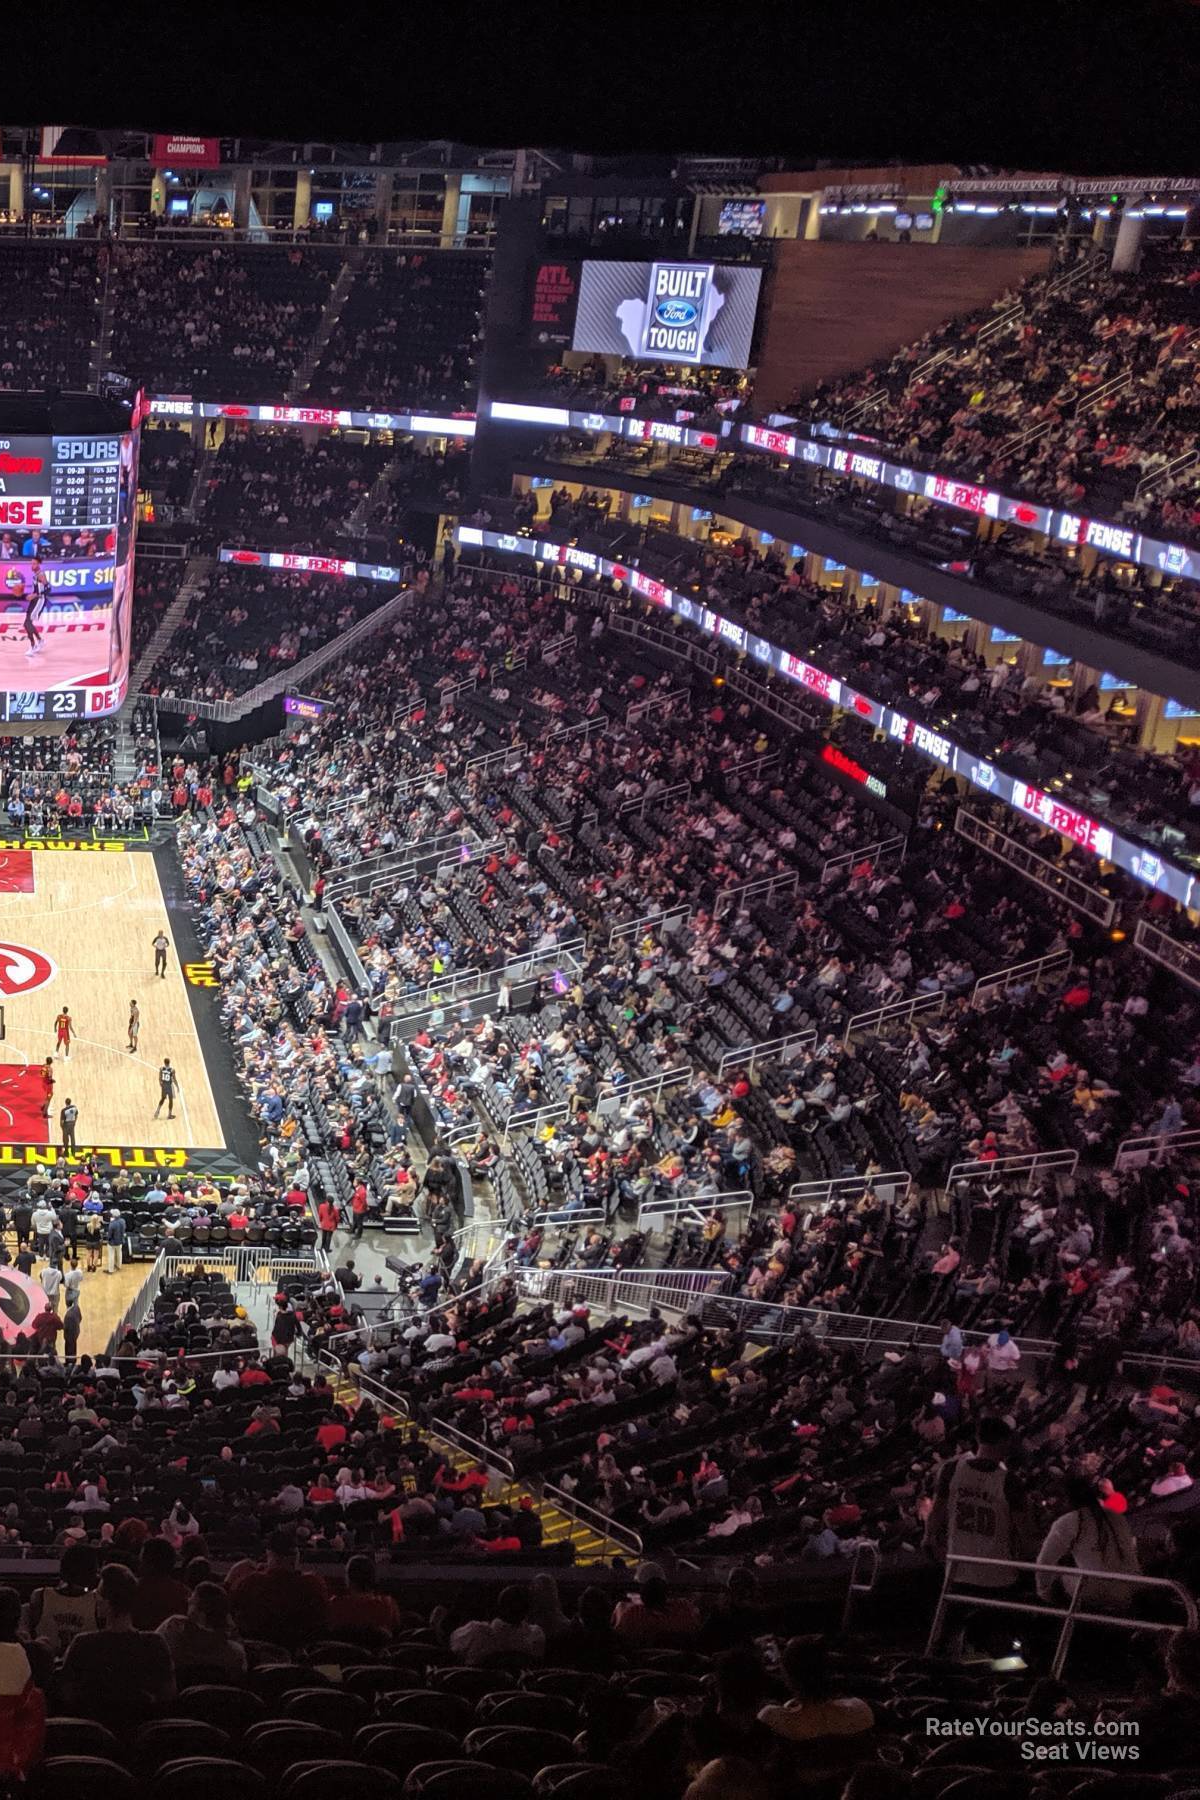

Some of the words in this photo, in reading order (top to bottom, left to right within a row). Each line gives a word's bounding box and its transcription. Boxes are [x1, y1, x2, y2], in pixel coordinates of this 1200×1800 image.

[167, 143, 205, 154] CHAMPIONS
[655, 269, 706, 298] BUILT
[663, 303, 687, 321] Ford
[649, 327, 697, 352] TOUGH
[0, 440, 11, 450] TO
[57, 440, 119, 460] SPURS
[66, 477, 85, 485] 02-09
[71, 497, 80, 506] 17
[1058, 513, 1134, 556] DEFENSE
[52, 693, 77, 713] 23
[889, 712, 951, 764] DEFENSE
